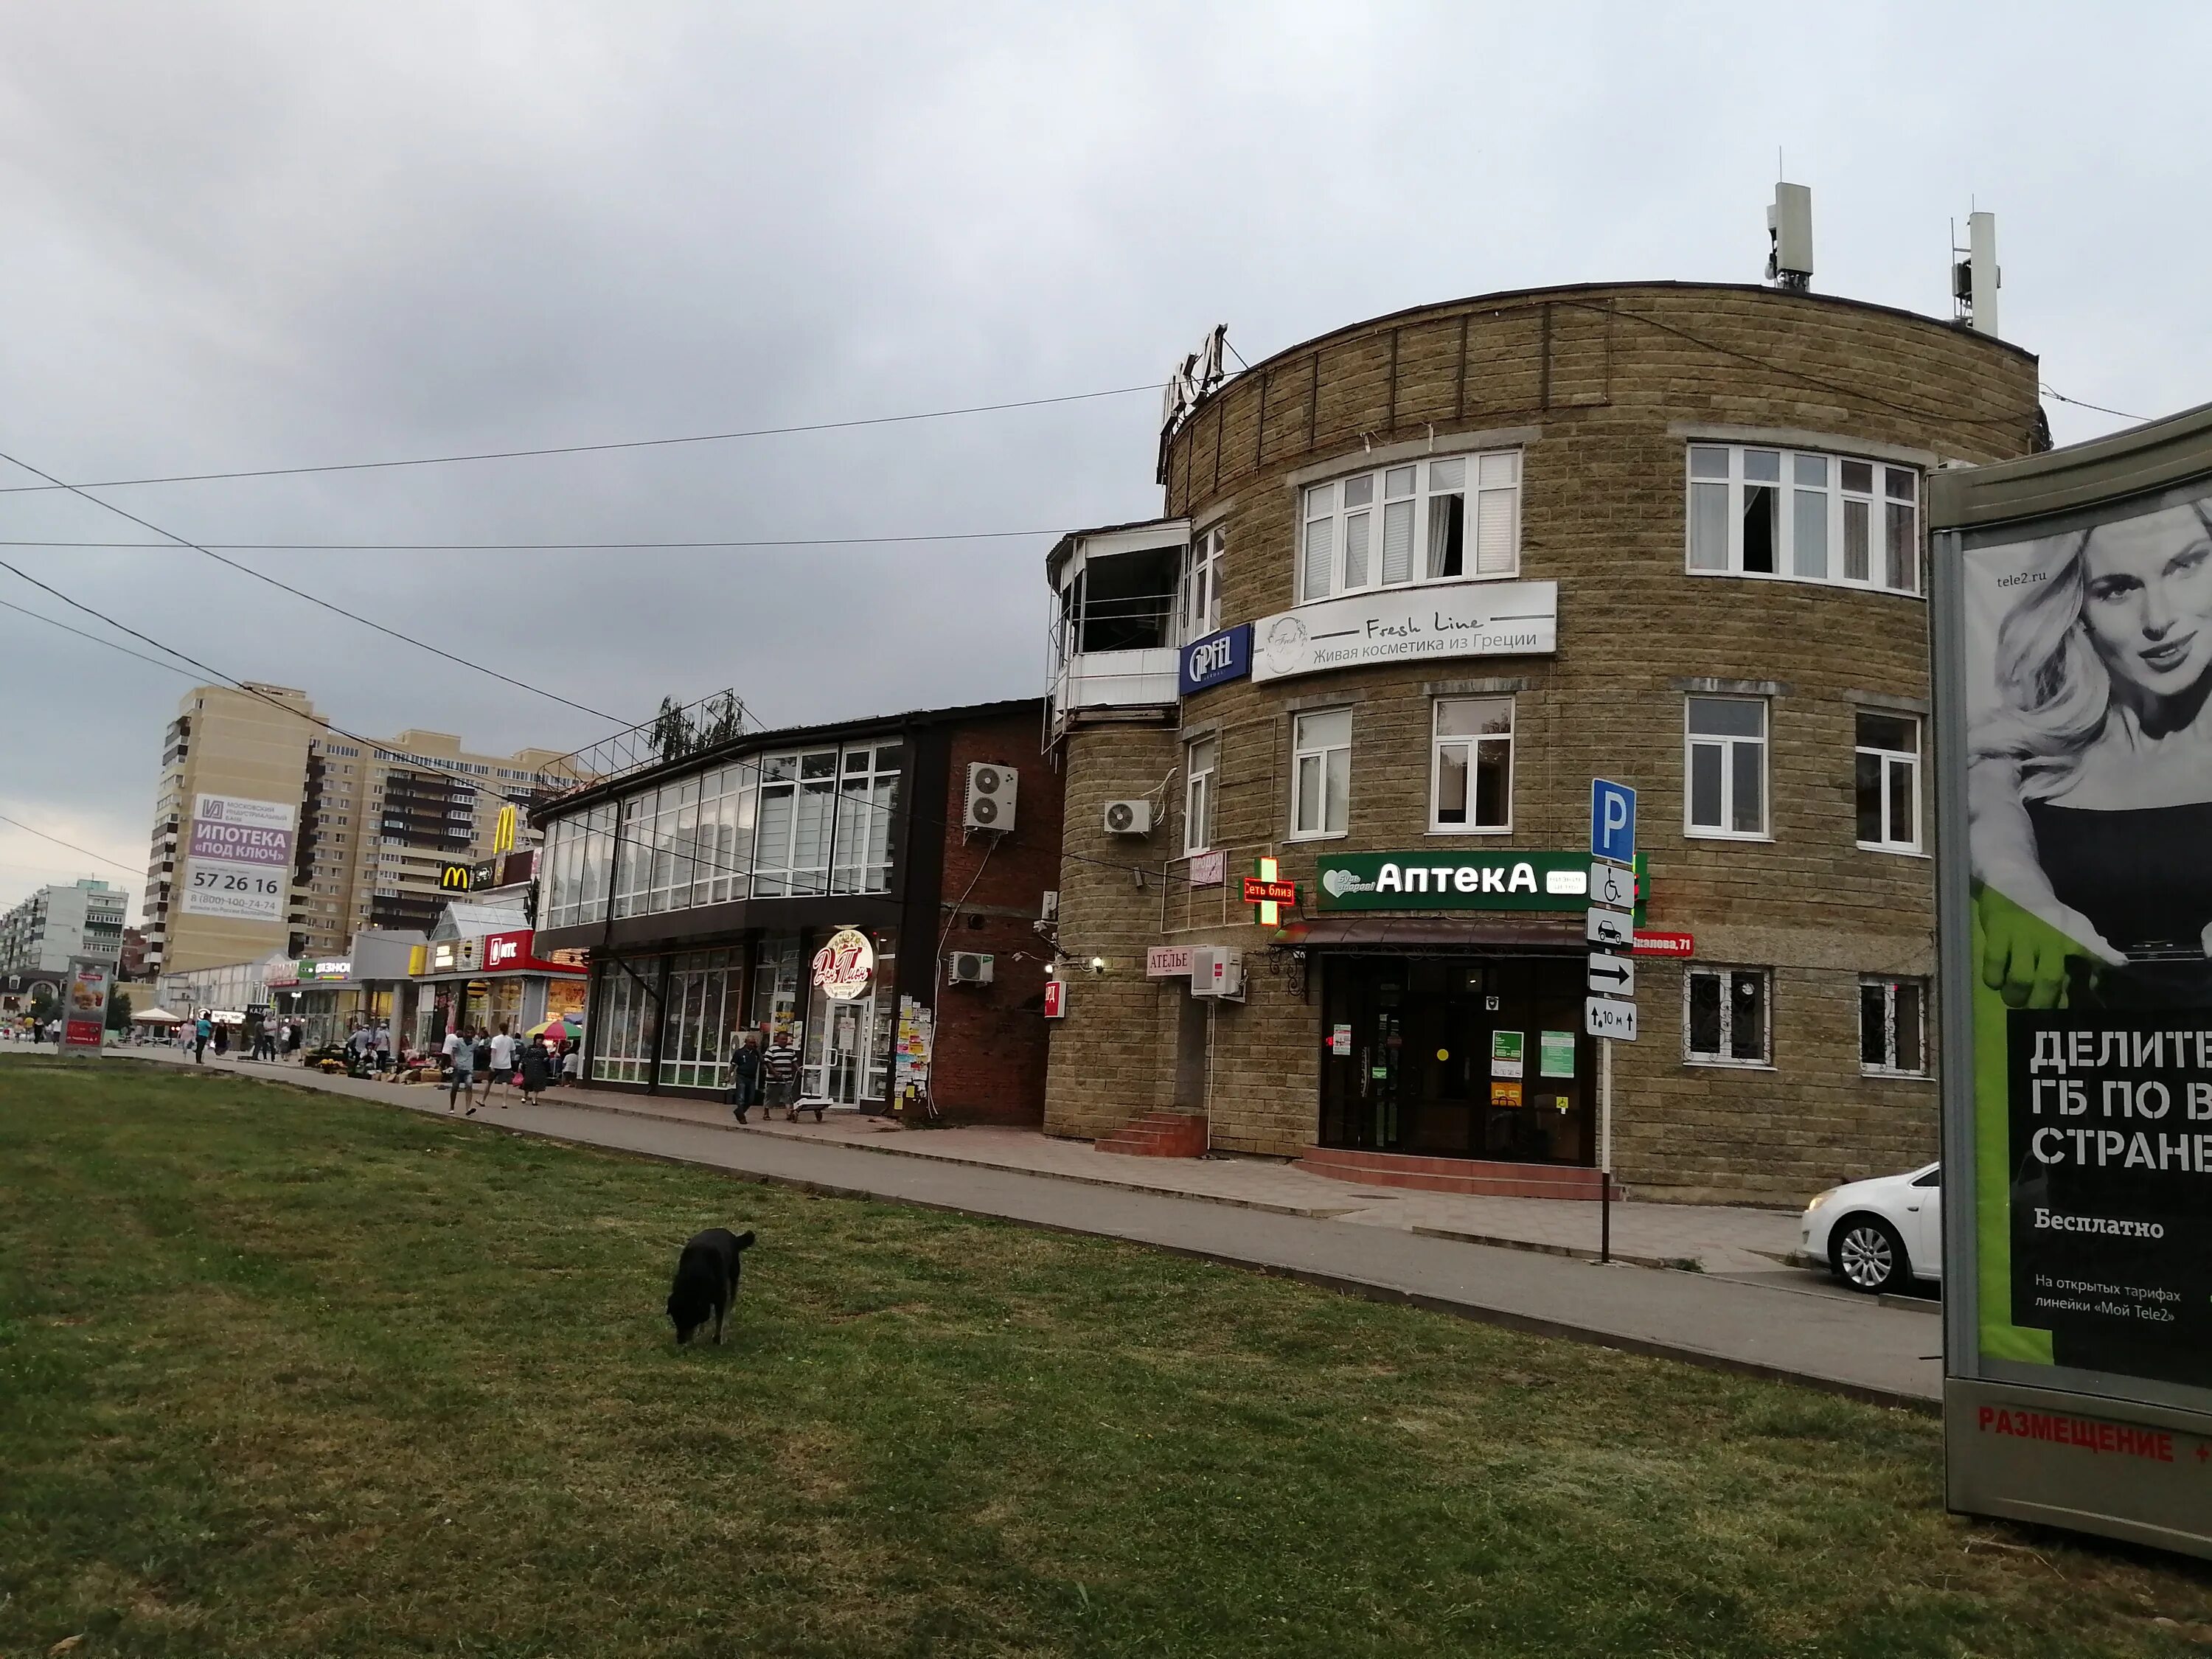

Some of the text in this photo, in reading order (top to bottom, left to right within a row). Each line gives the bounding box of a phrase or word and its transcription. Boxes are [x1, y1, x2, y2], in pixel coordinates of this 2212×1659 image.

[1997, 571, 2047, 588] tele2.ru
[1366, 612, 1484, 639] Fresh Line
[1314, 633, 1537, 664] Живая косметика из Греции
[1604, 790, 1627, 849] P
[197, 824, 286, 848] ИПОТЕКА
[195, 842, 284, 861] «ПОД КЛЮЧ»
[194, 872, 277, 894] 57 26 16
[1338, 874, 1361, 883] Будь
[1338, 882, 1376, 893] здоров!
[191, 894, 197, 902] 8
[199, 894, 224, 905] (800)
[1679, 939, 1690, 950] 71
[1150, 953, 1188, 969] АТЕЛЬЕ
[1603, 1011, 1613, 1025] 10
[2030, 1032, 2212, 1074] ДЕЛИТЕ
[2032, 1079, 2087, 1116] ГБ
[2102, 1080, 2171, 1119] ПО
[2032, 1127, 2212, 1172] СТРАНЕ
[2034, 1208, 2164, 1239] Бесплатно
[2035, 1274, 2181, 1302] На открытых тарифах
[2035, 1297, 2174, 1321] линейки «Мой Tele2»
[1978, 1406, 2174, 1463] РАЗМЕЩЕНИЕ
